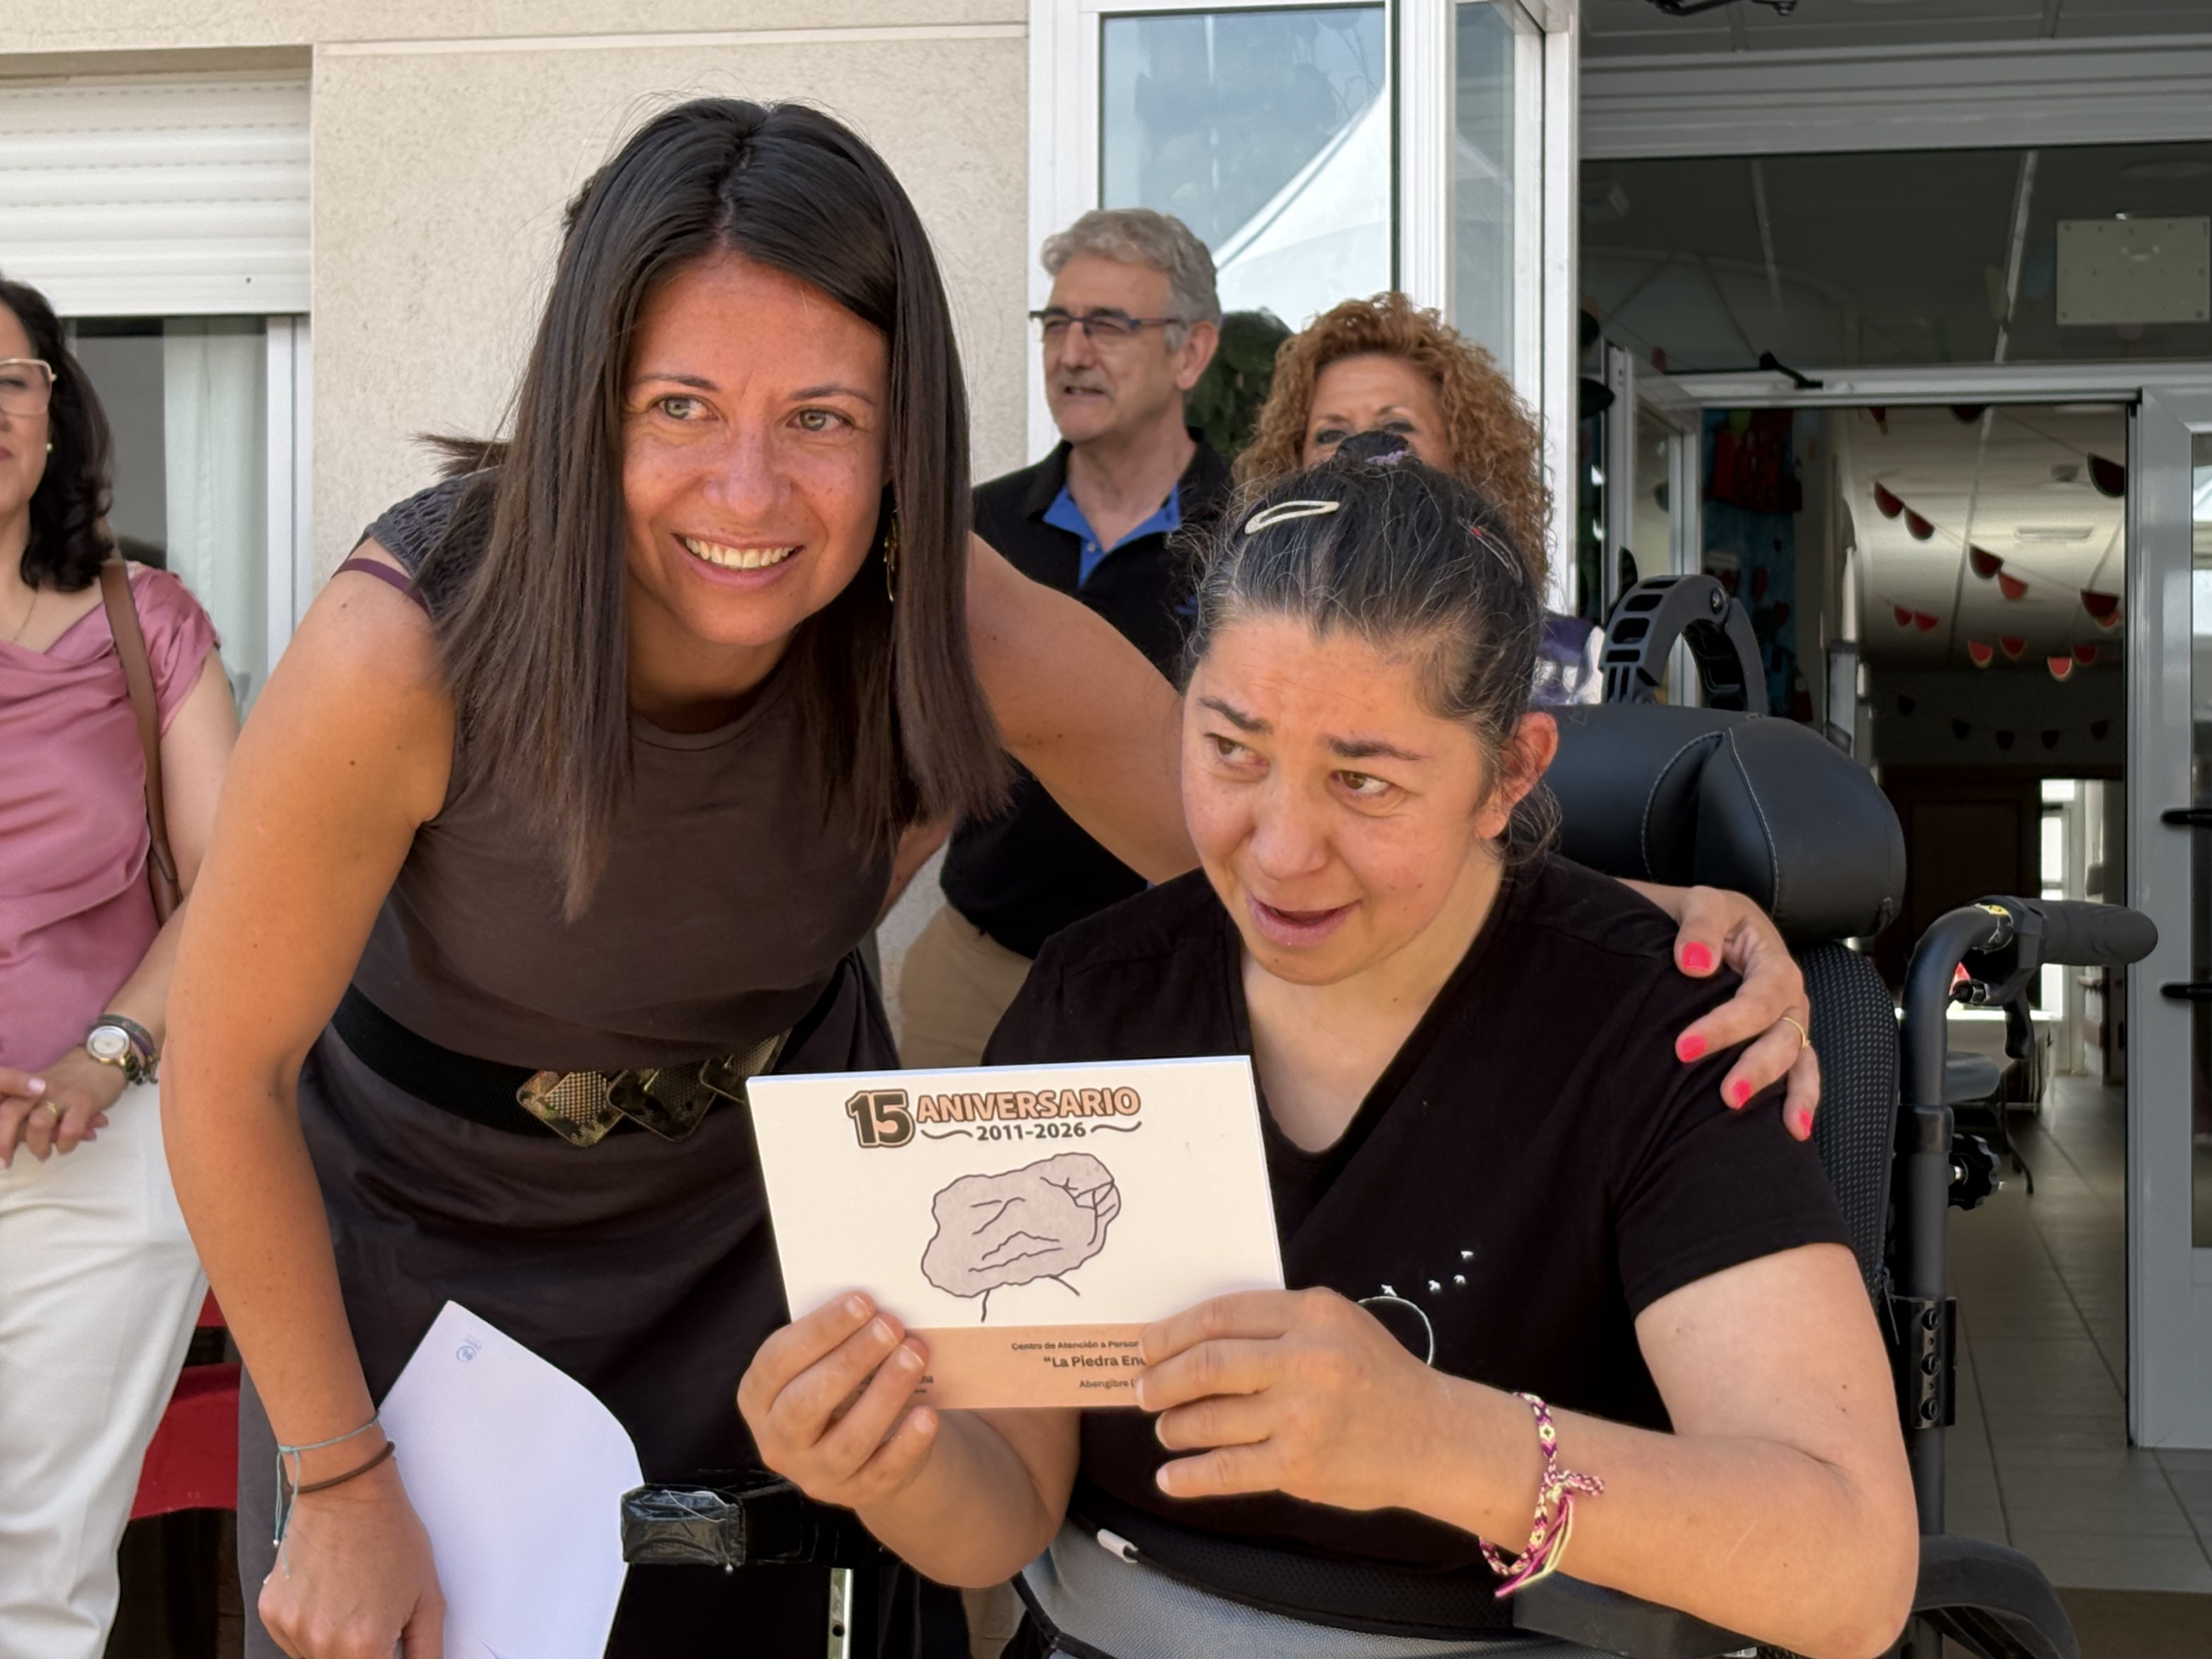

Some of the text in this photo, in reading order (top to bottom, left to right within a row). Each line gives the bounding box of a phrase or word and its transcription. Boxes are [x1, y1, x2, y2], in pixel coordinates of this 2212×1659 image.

[845, 1086, 1141, 1148] 15 ANIVERSARIO
[977, 1122, 1086, 1141] 2011-2026
[1011, 1342, 1042, 1350] Centro
[1044, 1341, 1056, 1350] de
[1057, 1340, 1098, 1349] Atención
[1071, 1355, 1119, 1368] Piedra
[1079, 1379, 1129, 1389] Abengibre
